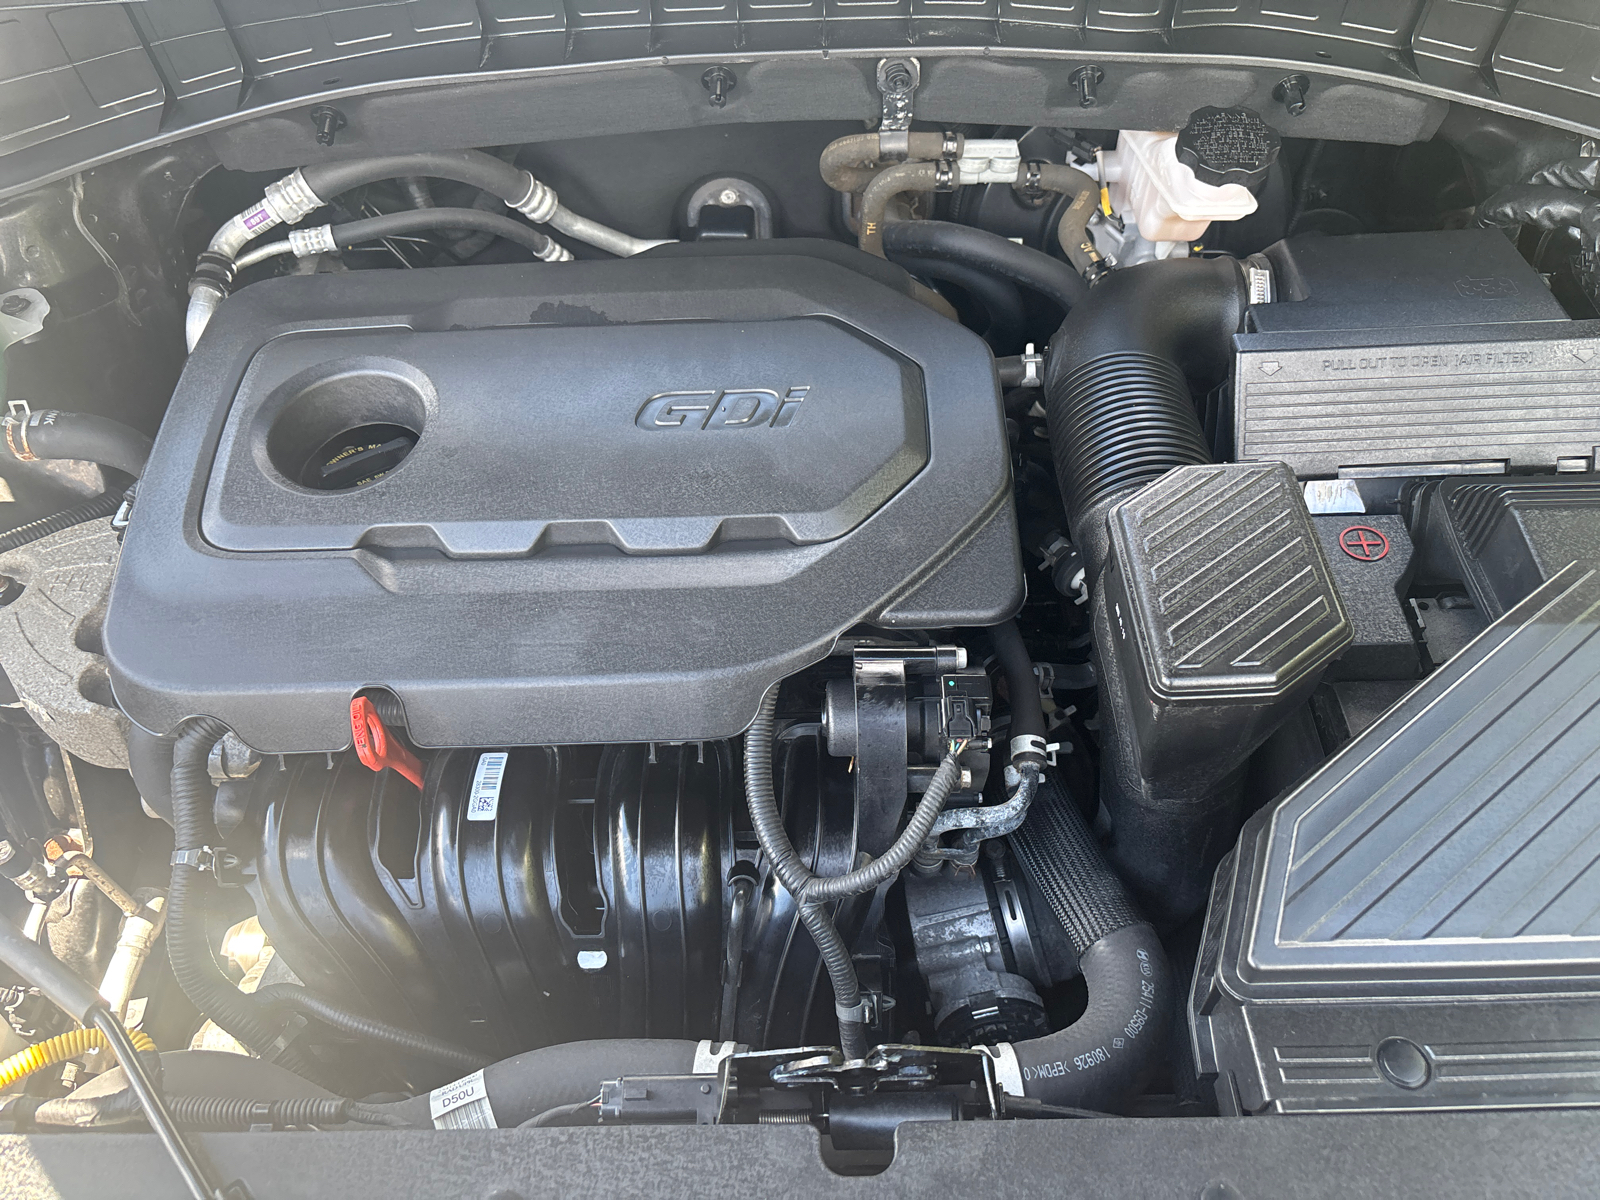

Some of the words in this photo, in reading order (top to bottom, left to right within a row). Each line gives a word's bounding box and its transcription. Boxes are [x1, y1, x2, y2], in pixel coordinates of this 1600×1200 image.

[866, 222, 877, 235] TH
[1322, 359, 1356, 371] PULL
[1360, 357, 1387, 370] OUT
[1389, 356, 1407, 369] TO
[1411, 355, 1448, 368] OPEN
[634, 386, 811, 431] GDi
[1073, 1046, 1111, 1071] 180926
[442, 1086, 475, 1108] D50U
